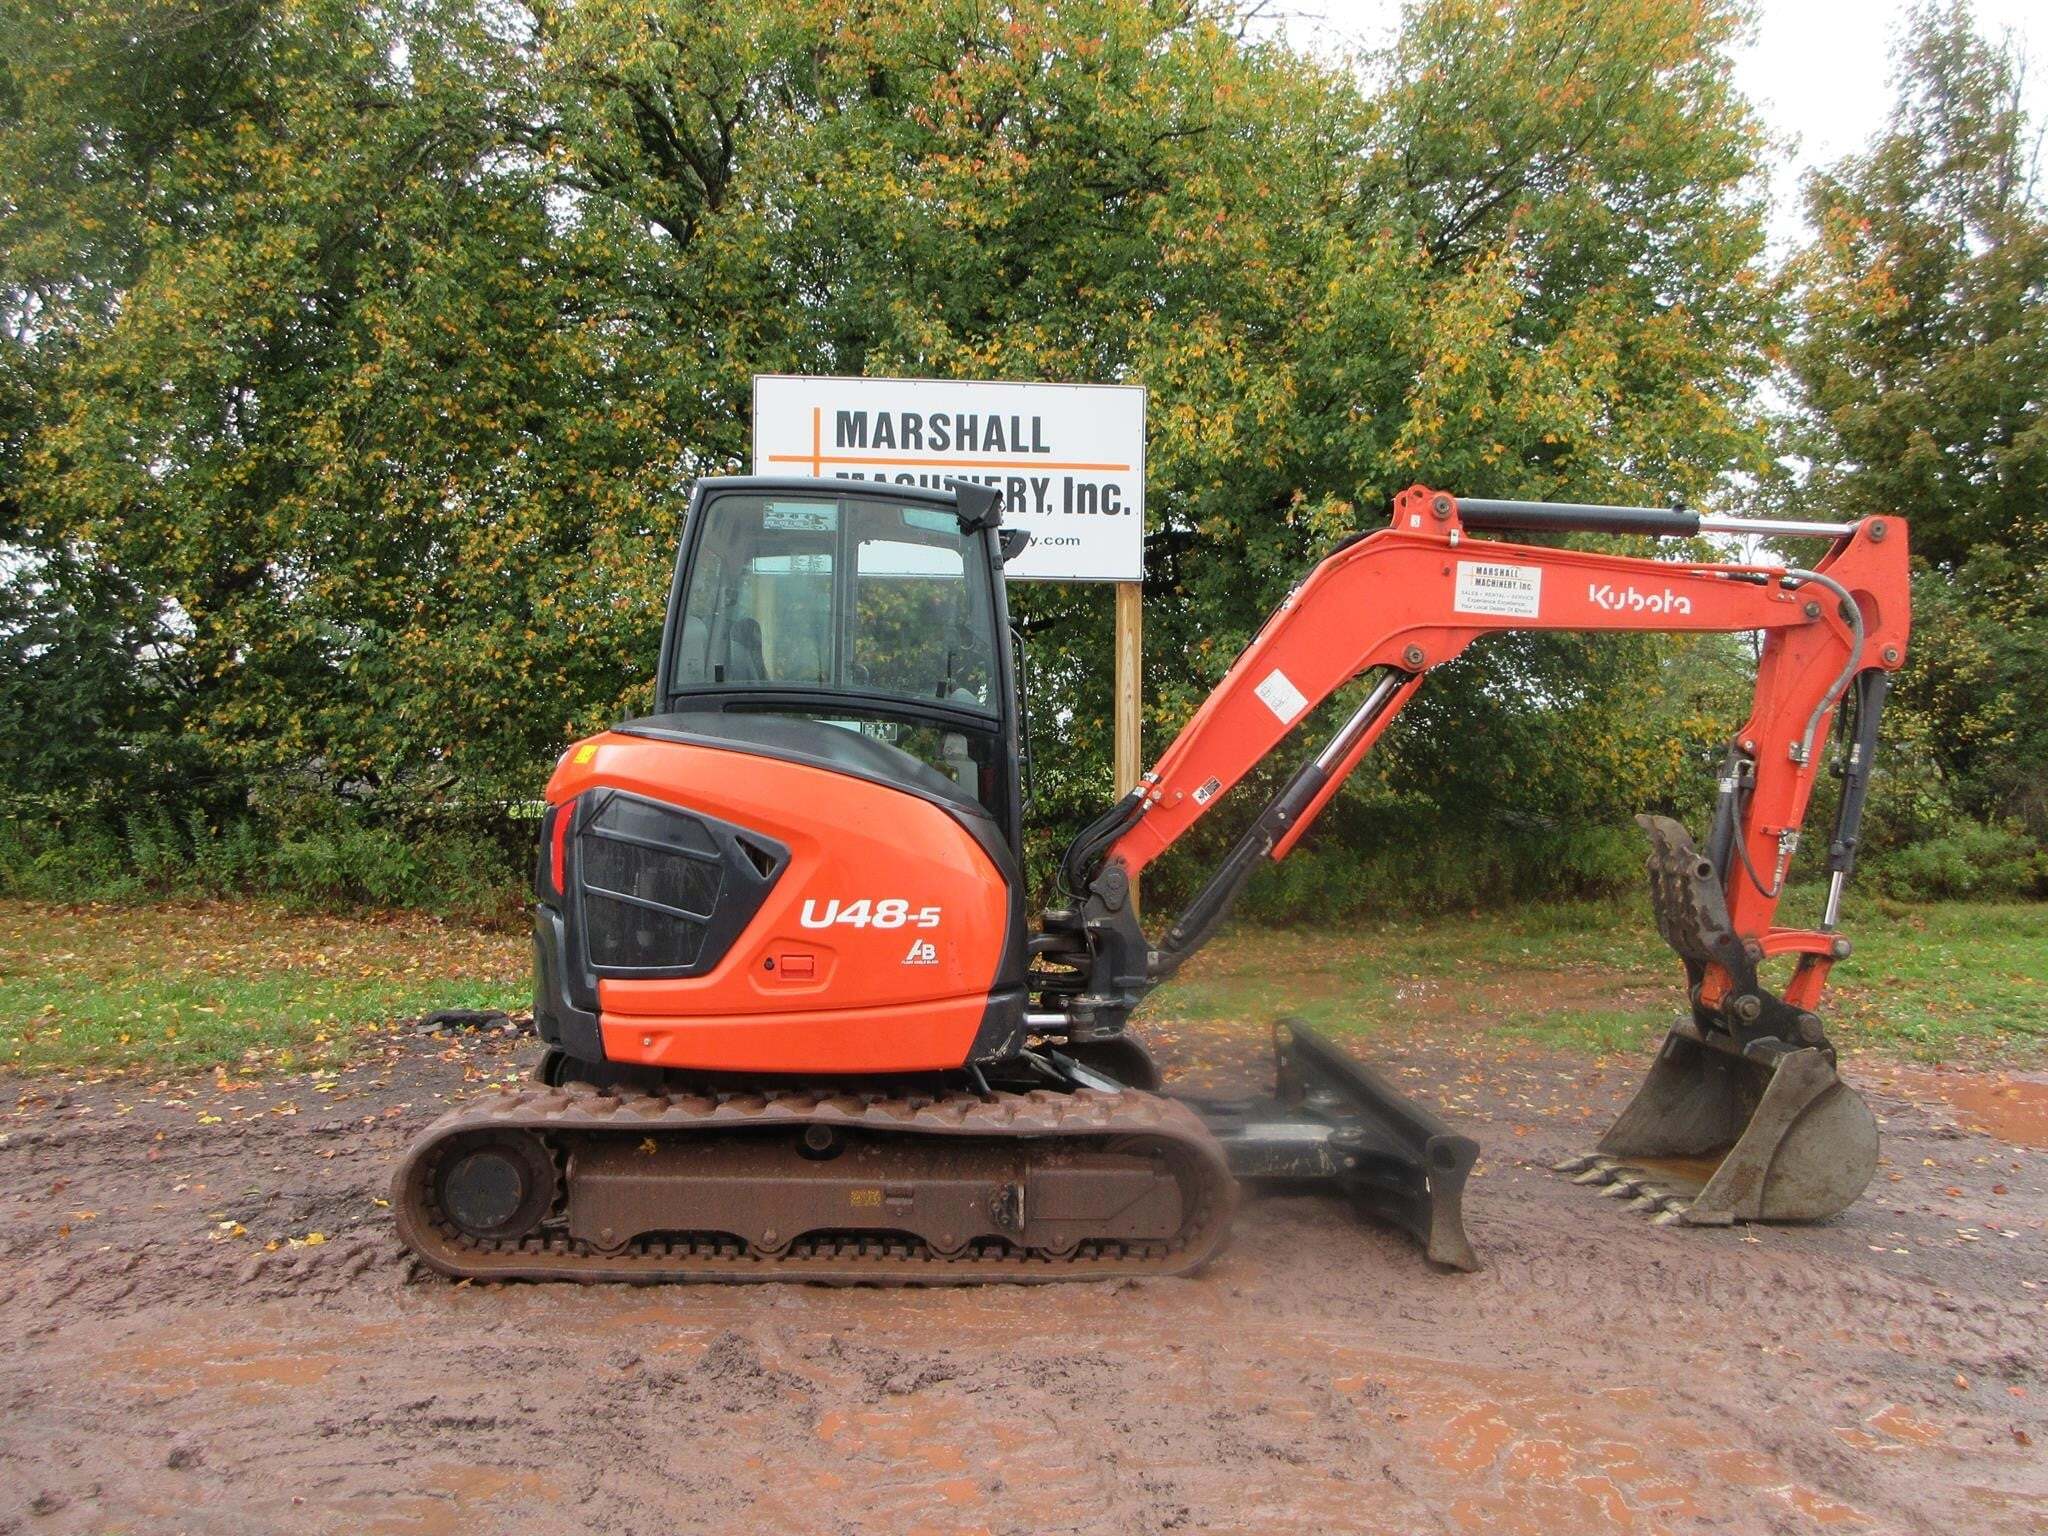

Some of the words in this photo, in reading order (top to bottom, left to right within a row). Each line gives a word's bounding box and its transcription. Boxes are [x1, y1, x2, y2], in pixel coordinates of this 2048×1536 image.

[836, 410, 1051, 454] MARSHALL
[1063, 476, 1131, 516] Inc.
[1476, 567, 1518, 578] MARSHALL
[1588, 583, 1692, 615] Kubota
[800, 898, 942, 929] U48-5
[905, 938, 936, 961] AB
